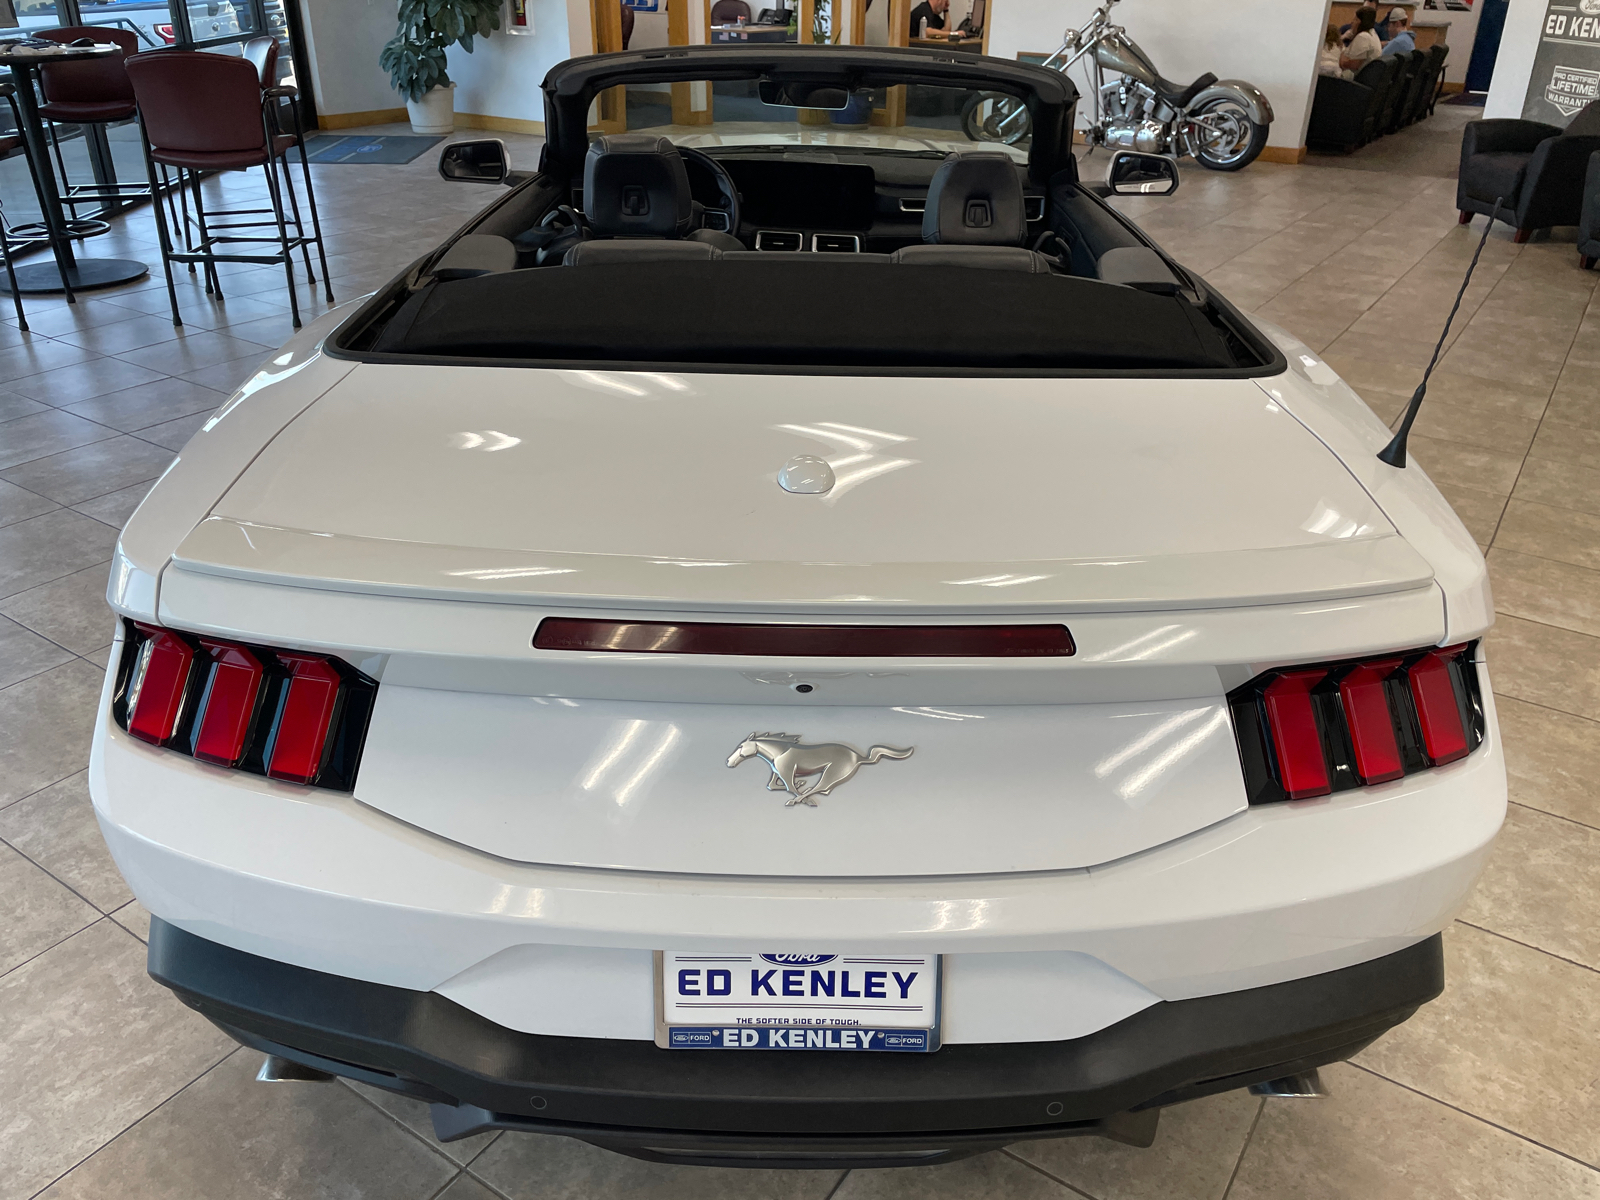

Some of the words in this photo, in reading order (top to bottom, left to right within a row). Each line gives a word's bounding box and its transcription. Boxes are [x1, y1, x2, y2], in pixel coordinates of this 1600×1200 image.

[1546, 15, 1567, 35] ED
[1551, 80, 1596, 96] LIFETIME
[1567, 74, 1598, 85] CERTIFIED
[678, 969, 731, 996] ED
[751, 969, 919, 999] KENLEY
[755, 1017, 790, 1025] SOFTER
[829, 1018, 862, 1026] TOUGH.
[723, 1028, 759, 1047] ED
[769, 1029, 876, 1049] KENLEY
